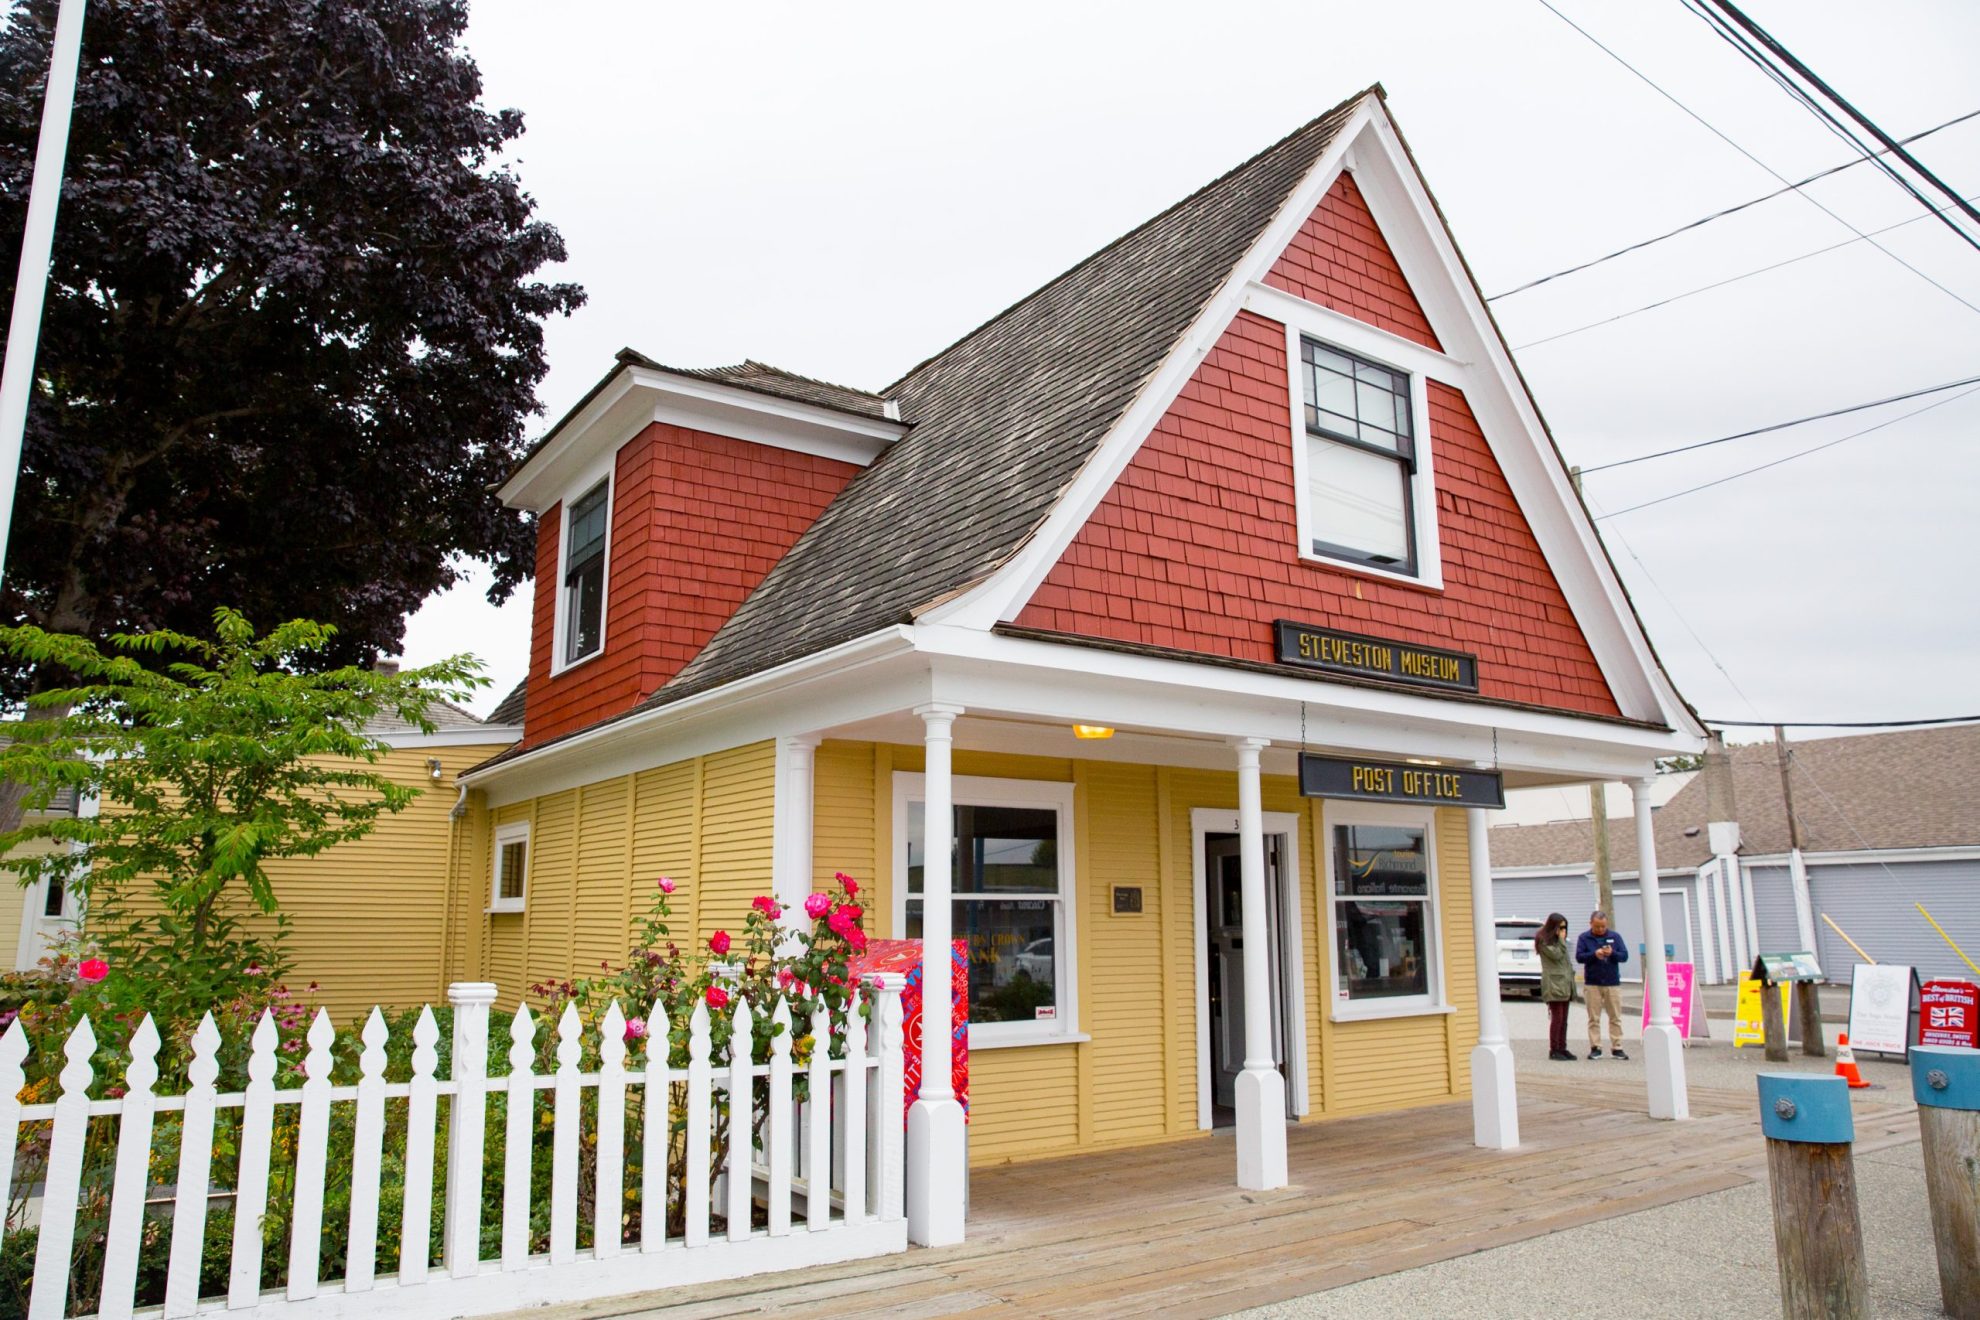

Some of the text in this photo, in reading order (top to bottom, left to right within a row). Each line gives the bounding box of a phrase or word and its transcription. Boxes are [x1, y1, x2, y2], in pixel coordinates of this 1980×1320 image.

[1299, 633, 1461, 682] STEVESTON MUSEUM
[1352, 766, 1463, 798] POST OFFICE
